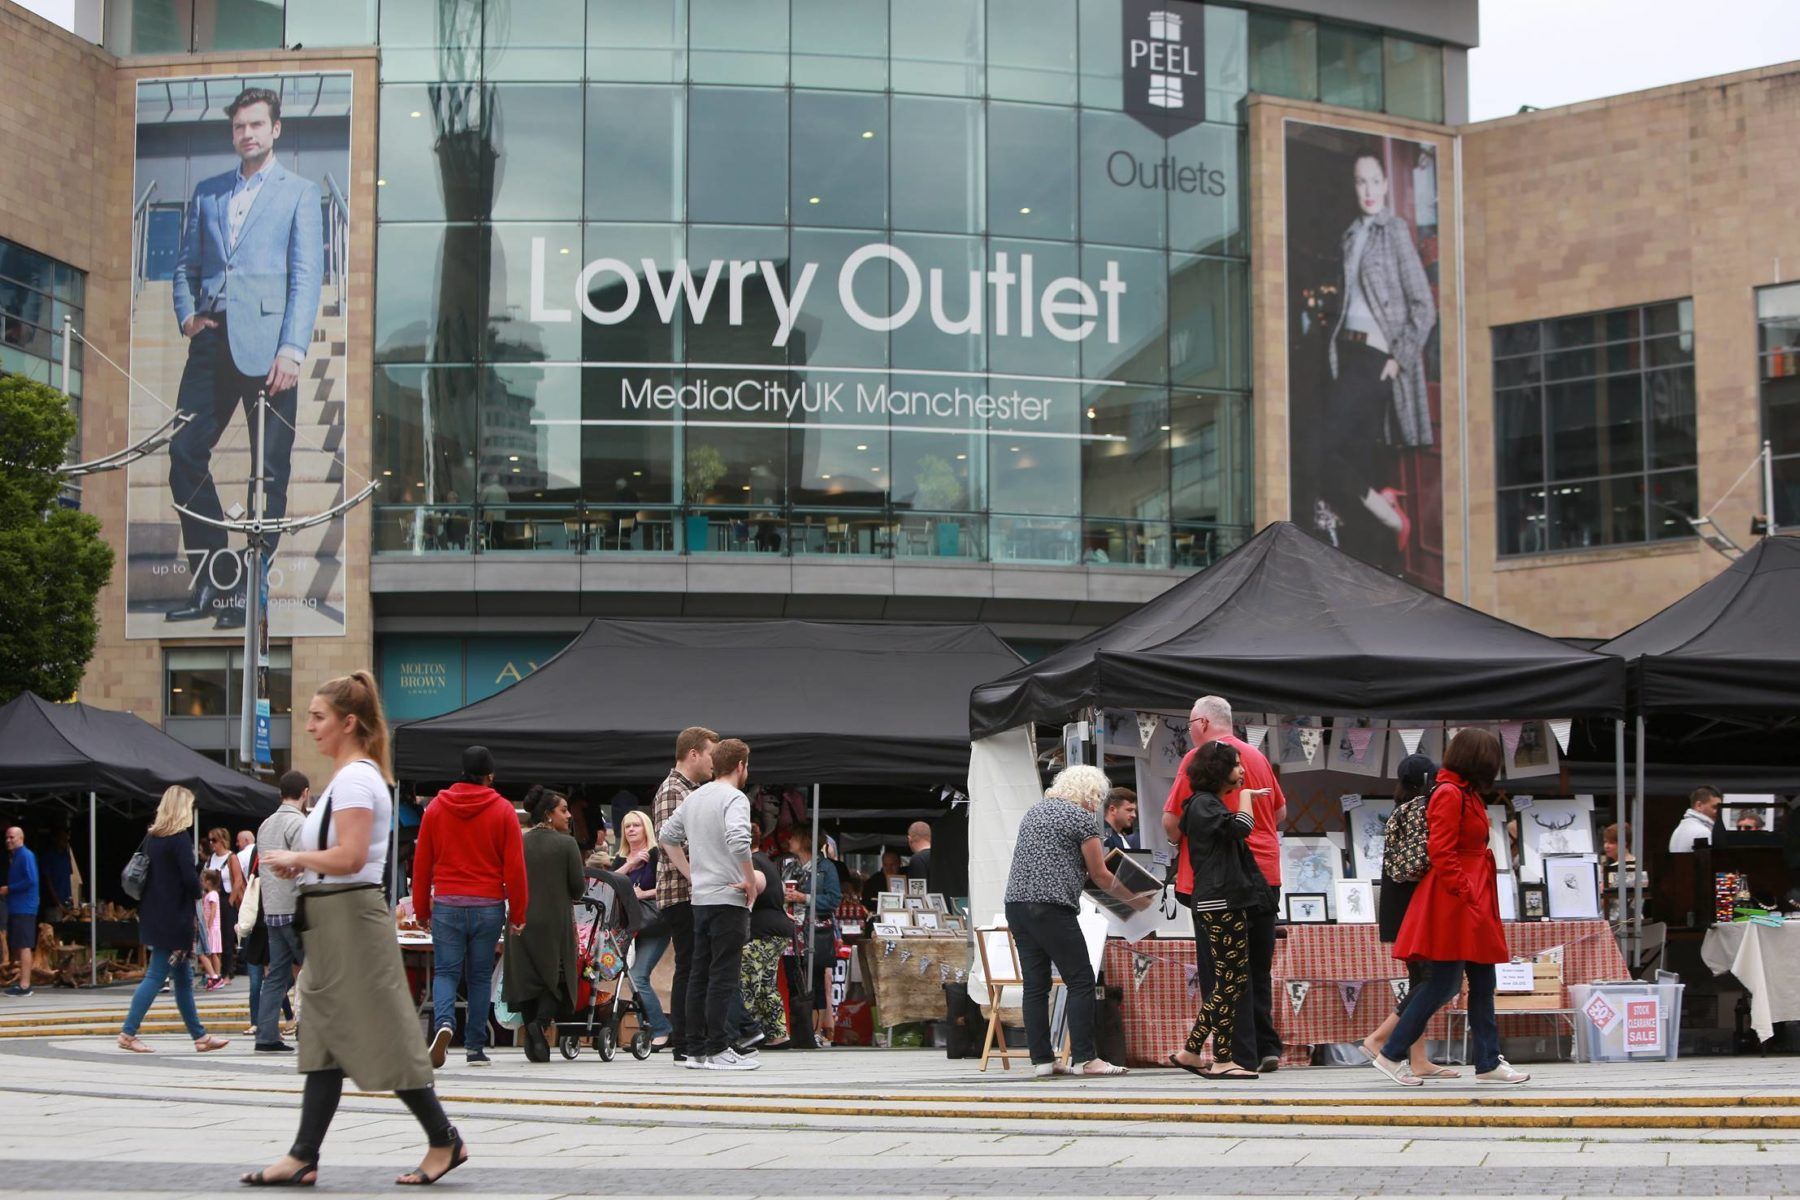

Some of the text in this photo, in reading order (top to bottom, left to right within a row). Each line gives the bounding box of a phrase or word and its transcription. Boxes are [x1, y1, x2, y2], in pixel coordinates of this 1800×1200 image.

[1130, 39, 1199, 76] PEEL
[1107, 150, 1226, 197] Outlets
[531, 236, 1128, 347] Lowry Outlet
[621, 377, 1052, 421] MediaCityUK Manchester
[152, 565, 165, 576] up
[173, 563, 187, 574] to
[212, 593, 247, 608] outle
[400, 663, 446, 675] MOLTON
[400, 676, 446, 688] BROWN
[1629, 1031, 1656, 1042] SALE
